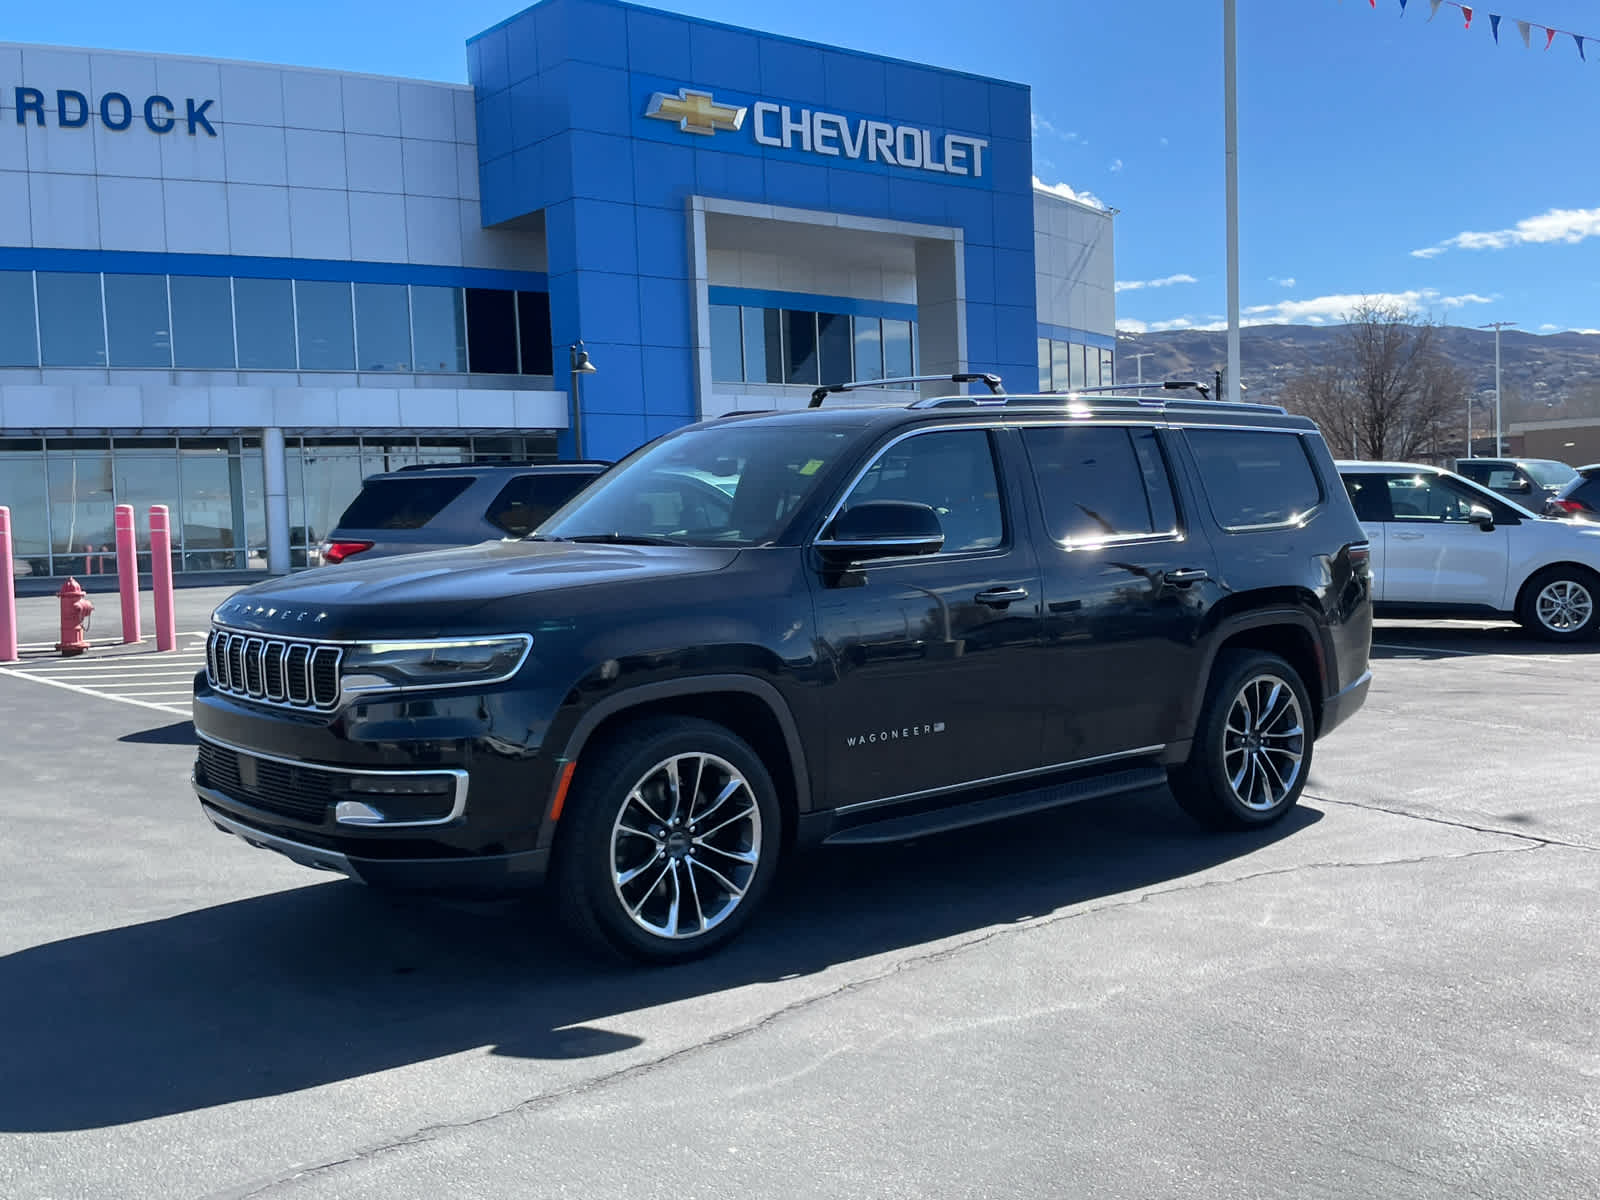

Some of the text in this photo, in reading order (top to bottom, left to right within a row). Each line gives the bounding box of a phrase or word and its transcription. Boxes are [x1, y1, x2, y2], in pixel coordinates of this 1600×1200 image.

[0, 86, 218, 137] RDOCK
[753, 101, 989, 177] CHEVROLET
[846, 724, 931, 747] WAGONEER
